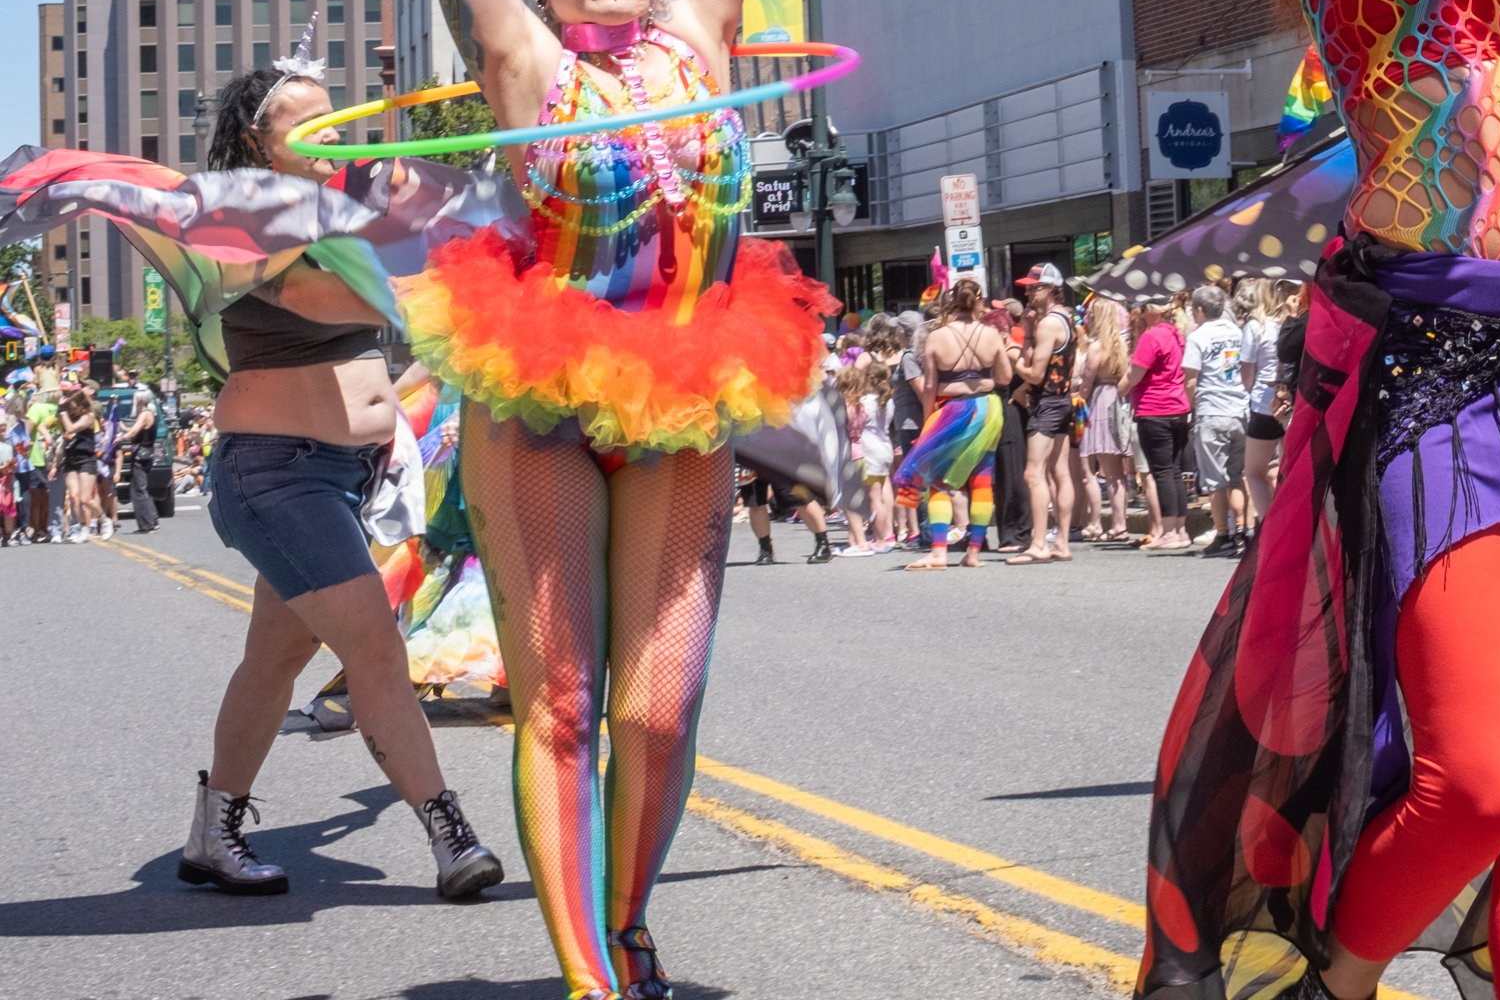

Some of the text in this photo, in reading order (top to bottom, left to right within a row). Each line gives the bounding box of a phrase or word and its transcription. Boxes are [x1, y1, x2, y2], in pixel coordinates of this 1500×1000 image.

[953, 179, 965, 190] NO
[767, 191, 783, 202] at
[944, 191, 976, 202] PARKING
[763, 201, 791, 213] Prid
